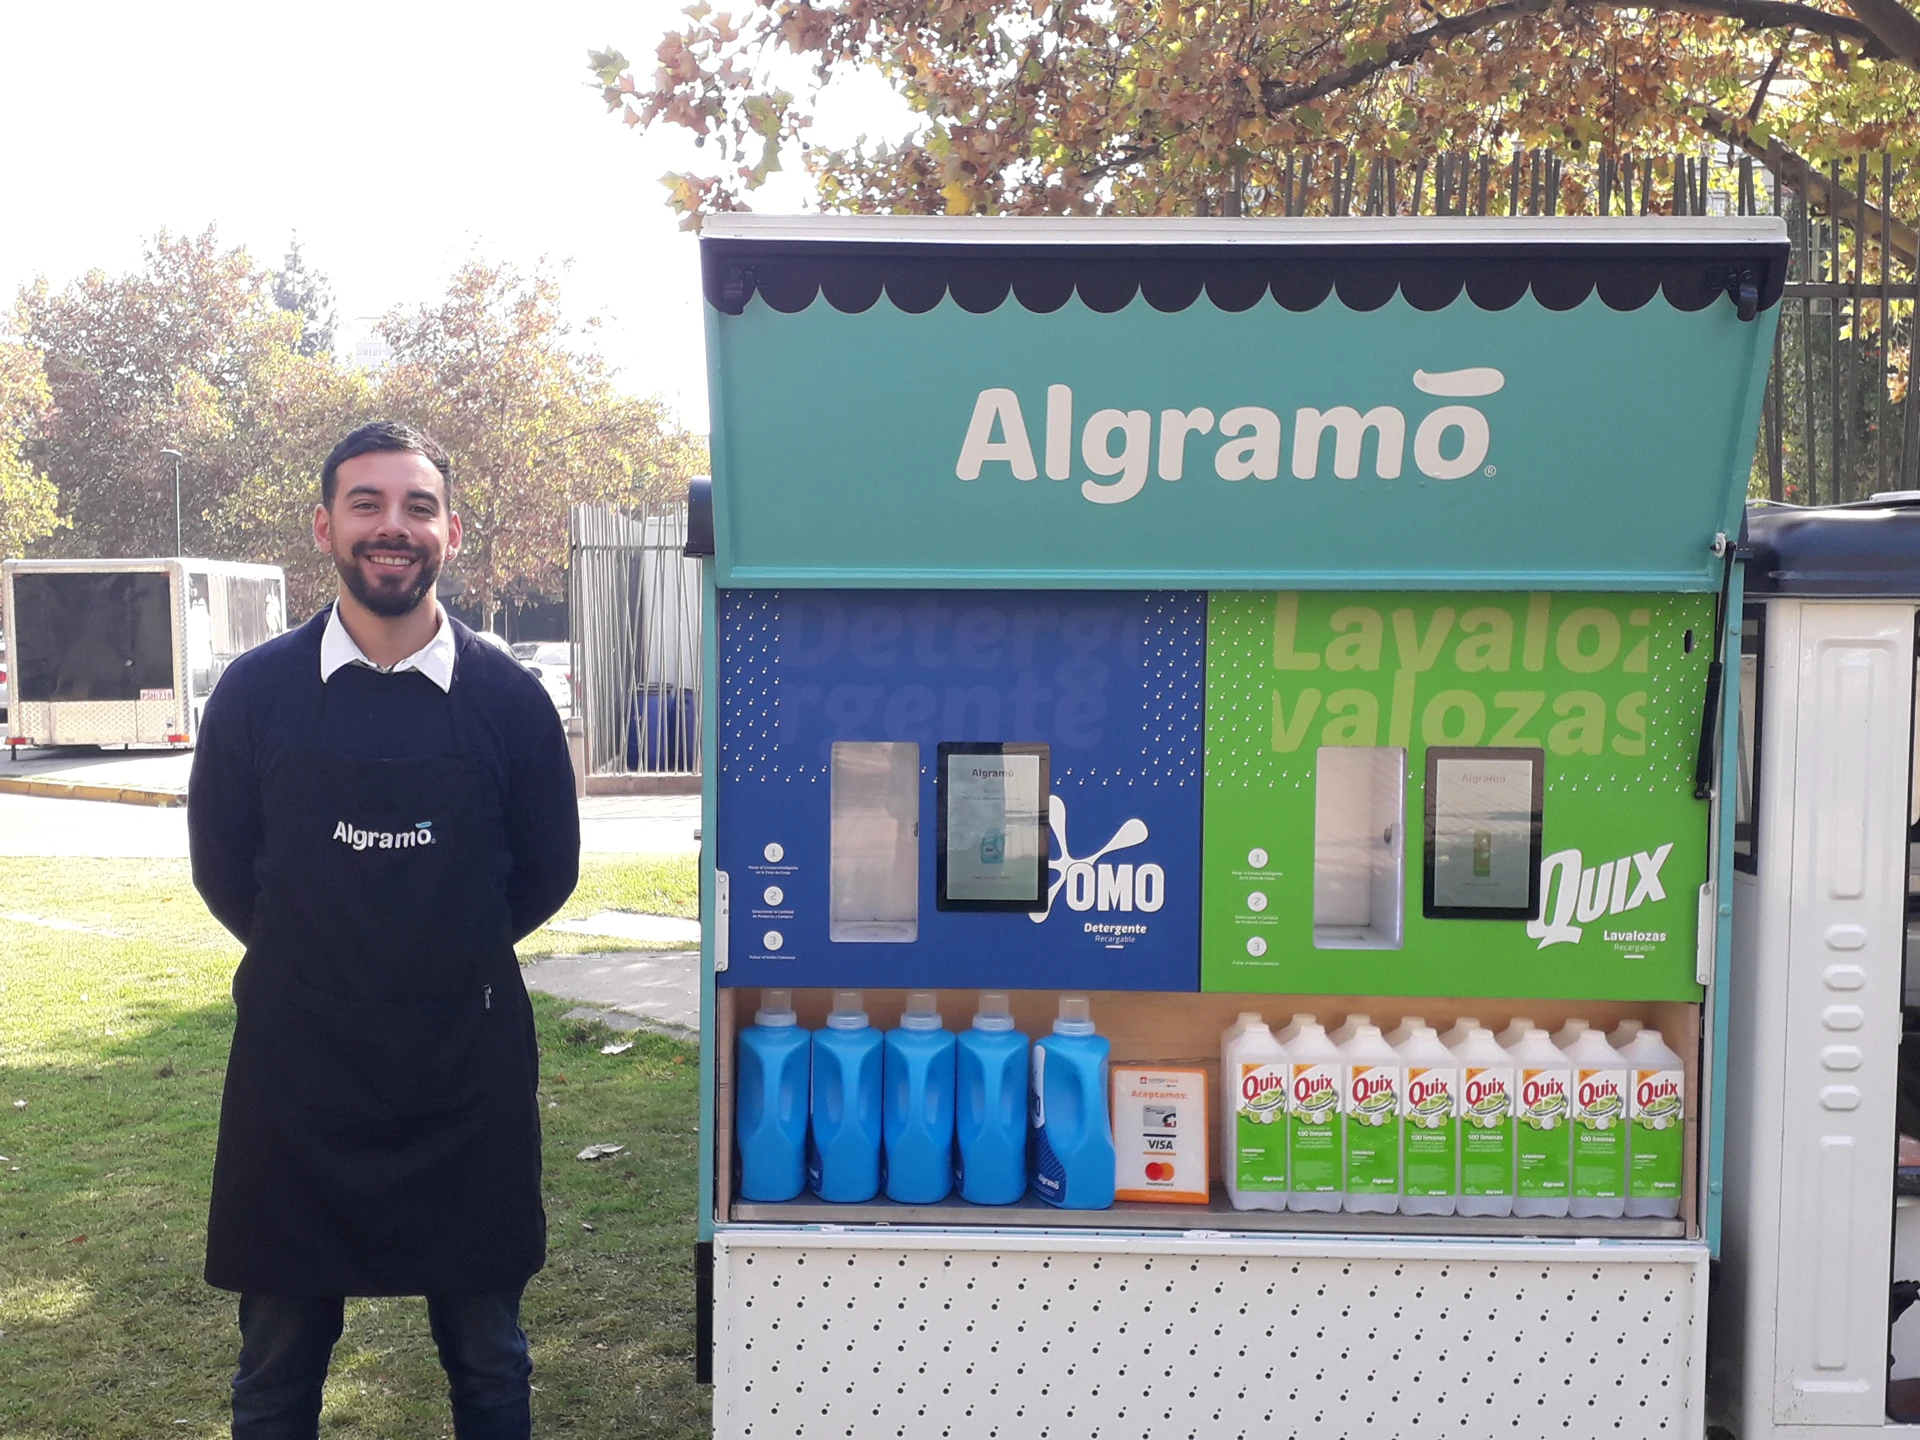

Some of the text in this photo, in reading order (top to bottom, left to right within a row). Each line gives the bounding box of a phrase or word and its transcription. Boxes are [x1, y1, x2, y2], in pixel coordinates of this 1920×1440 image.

[1066, 862, 1165, 912] OMO
[1083, 922, 1148, 936] Detergente
[1094, 935, 1136, 945] Recargable
[1603, 929, 1667, 942] Lavalozas
[1613, 944, 1656, 953] Recargable
[1131, 1089, 1188, 1101] Aceptamos:
[1242, 1072, 1284, 1104] Quix
[1294, 1074, 1333, 1104] Quix
[1352, 1074, 1393, 1106] Quix
[1408, 1077, 1448, 1108] Quix
[1465, 1077, 1505, 1108] Quix
[1522, 1077, 1564, 1109] Quix
[1578, 1079, 1618, 1110] Quix
[1636, 1078, 1678, 1110] Quix
[1147, 1140, 1173, 1150] VISA
